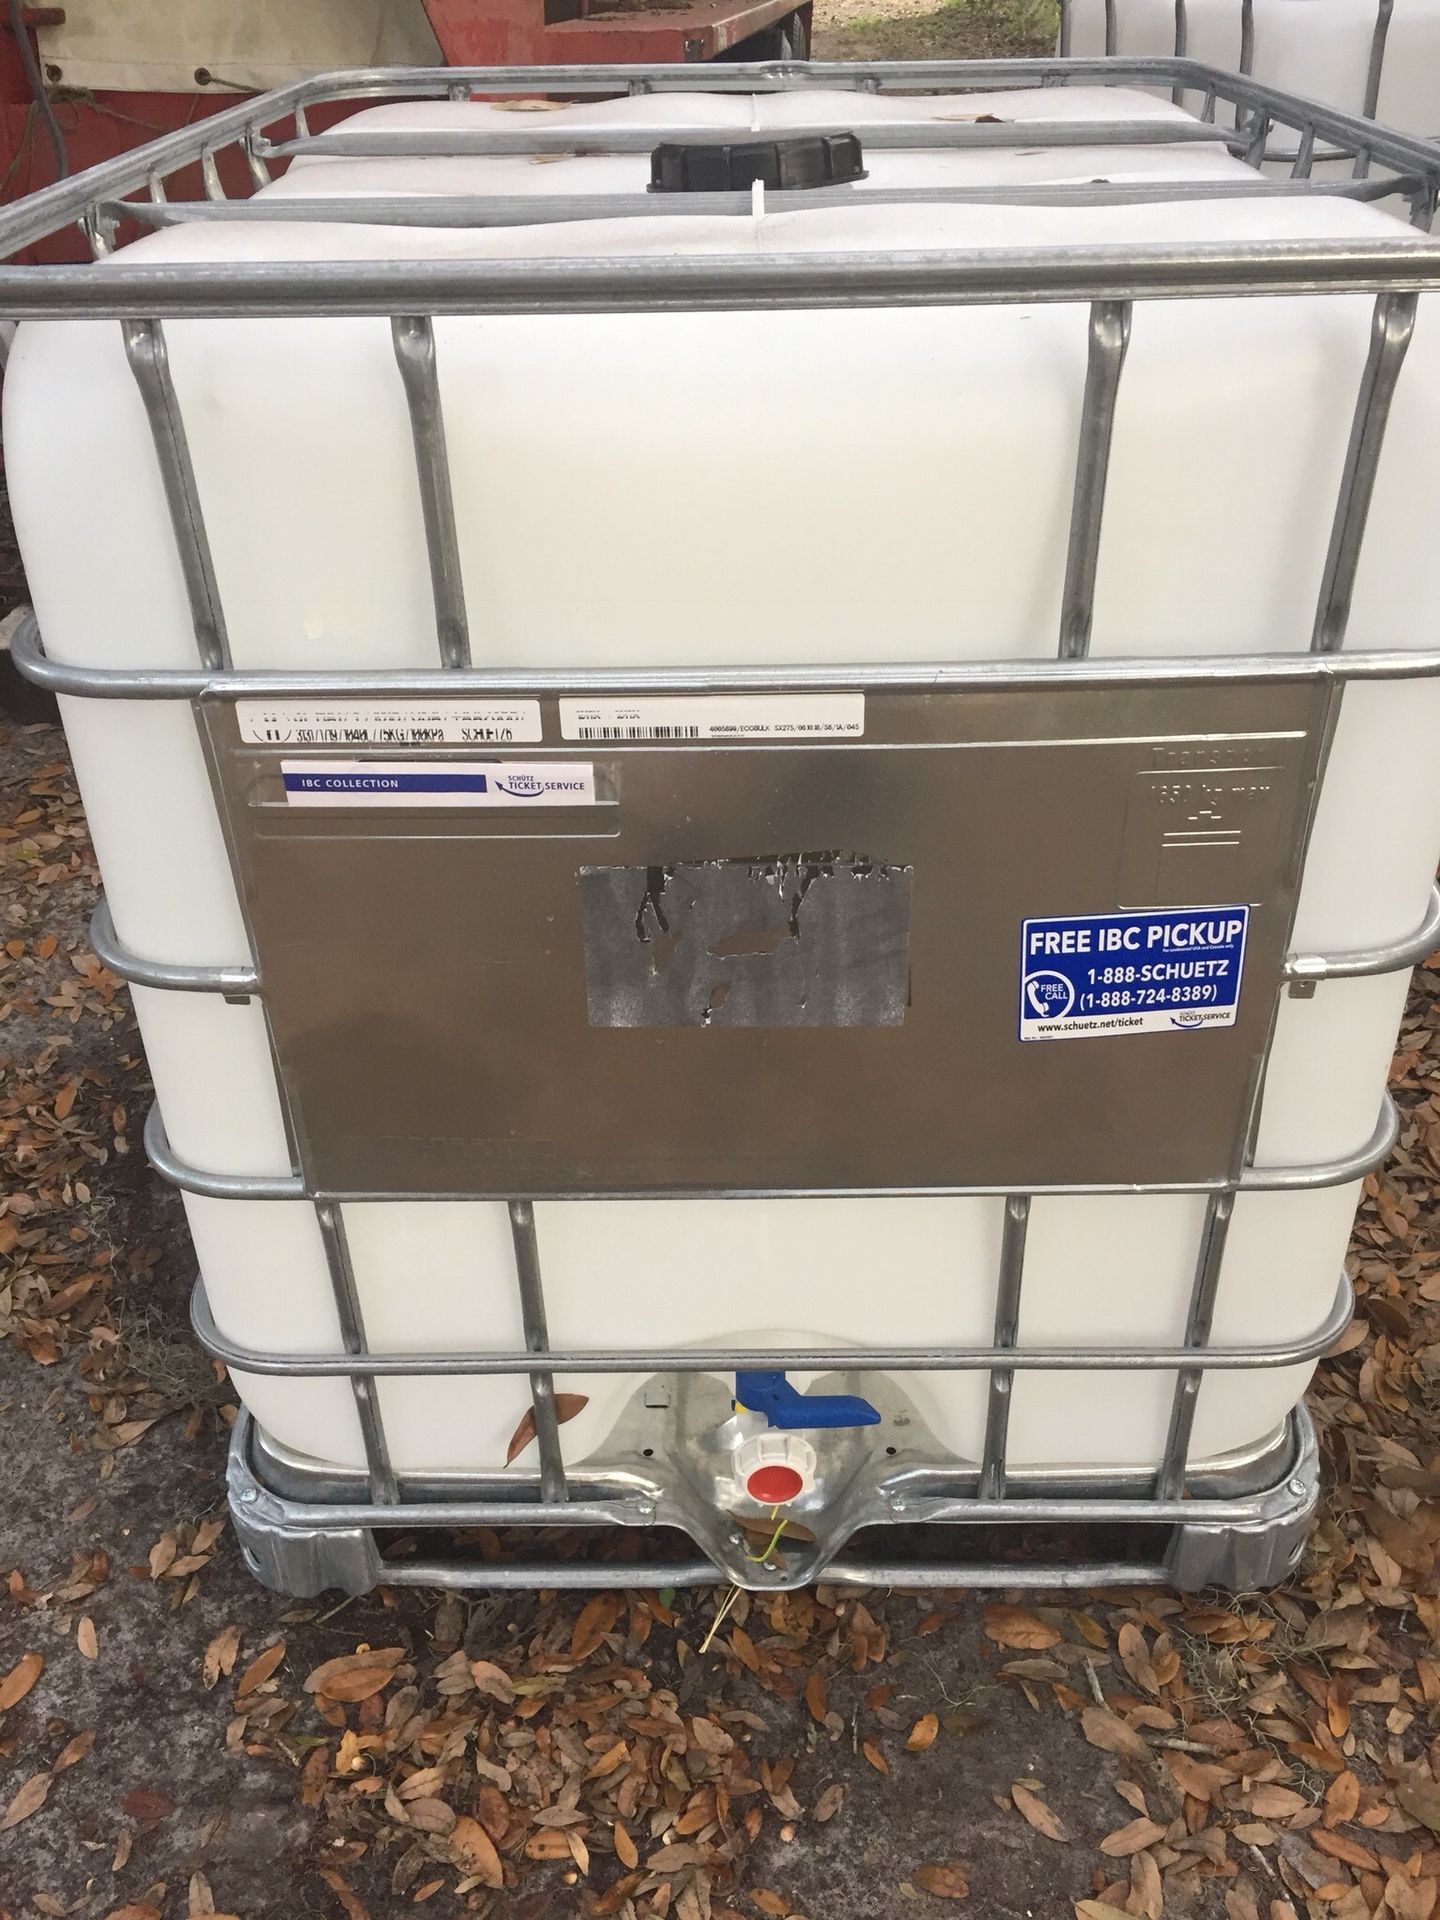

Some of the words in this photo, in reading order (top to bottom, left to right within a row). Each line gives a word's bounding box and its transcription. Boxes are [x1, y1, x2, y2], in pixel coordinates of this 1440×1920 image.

[302, 779, 321, 787] IBC
[325, 779, 399, 788] COLLECTION
[508, 781, 542, 790] TICKET
[544, 782, 585, 790] SERVICE
[1030, 930, 1092, 955] FREE
[1099, 926, 1141, 951] IBC
[1147, 920, 1242, 948] PICKUP
[1087, 959, 1230, 985] 1-888-SCHUETZ
[1040, 983, 1064, 993] FREE
[1045, 991, 1068, 1000] CALL
[1080, 985, 1217, 1011] (1-888-724-8389)
[1203, 1012, 1231, 1020] SERVICE
[1037, 1016, 1144, 1033] www.schuetz.net/ticket
